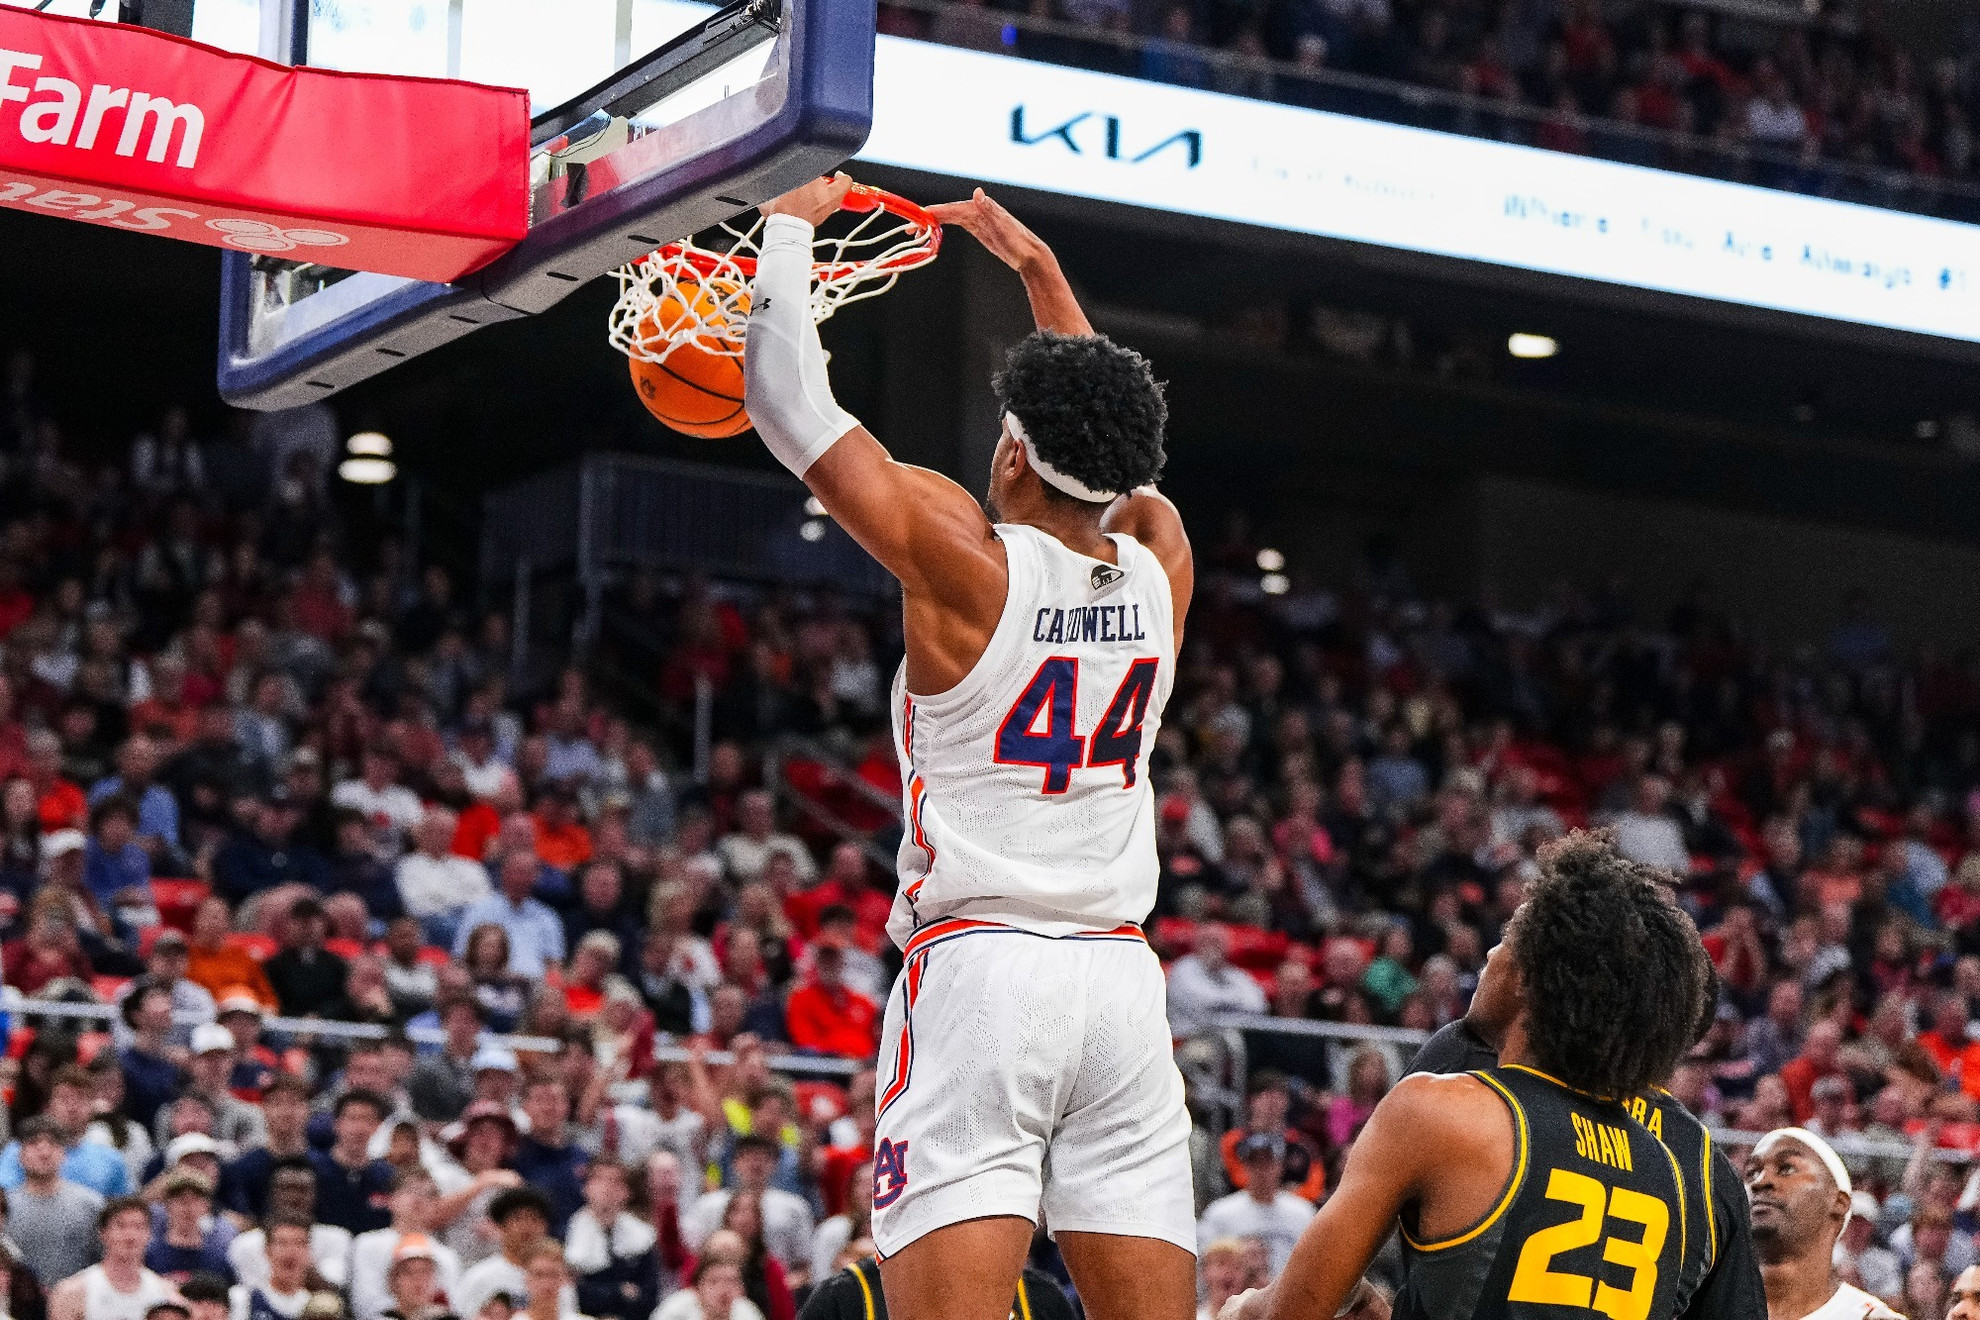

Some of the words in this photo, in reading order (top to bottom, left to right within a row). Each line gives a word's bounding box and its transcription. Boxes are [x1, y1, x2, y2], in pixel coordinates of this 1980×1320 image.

[0, 48, 205, 169] Farm
[1010, 103, 1203, 169] KIA
[994, 656, 1160, 795] 44
[1570, 1111, 1634, 1173] SHAW
[1622, 1096, 1662, 1140] RA
[1507, 1167, 1670, 1320] 23
